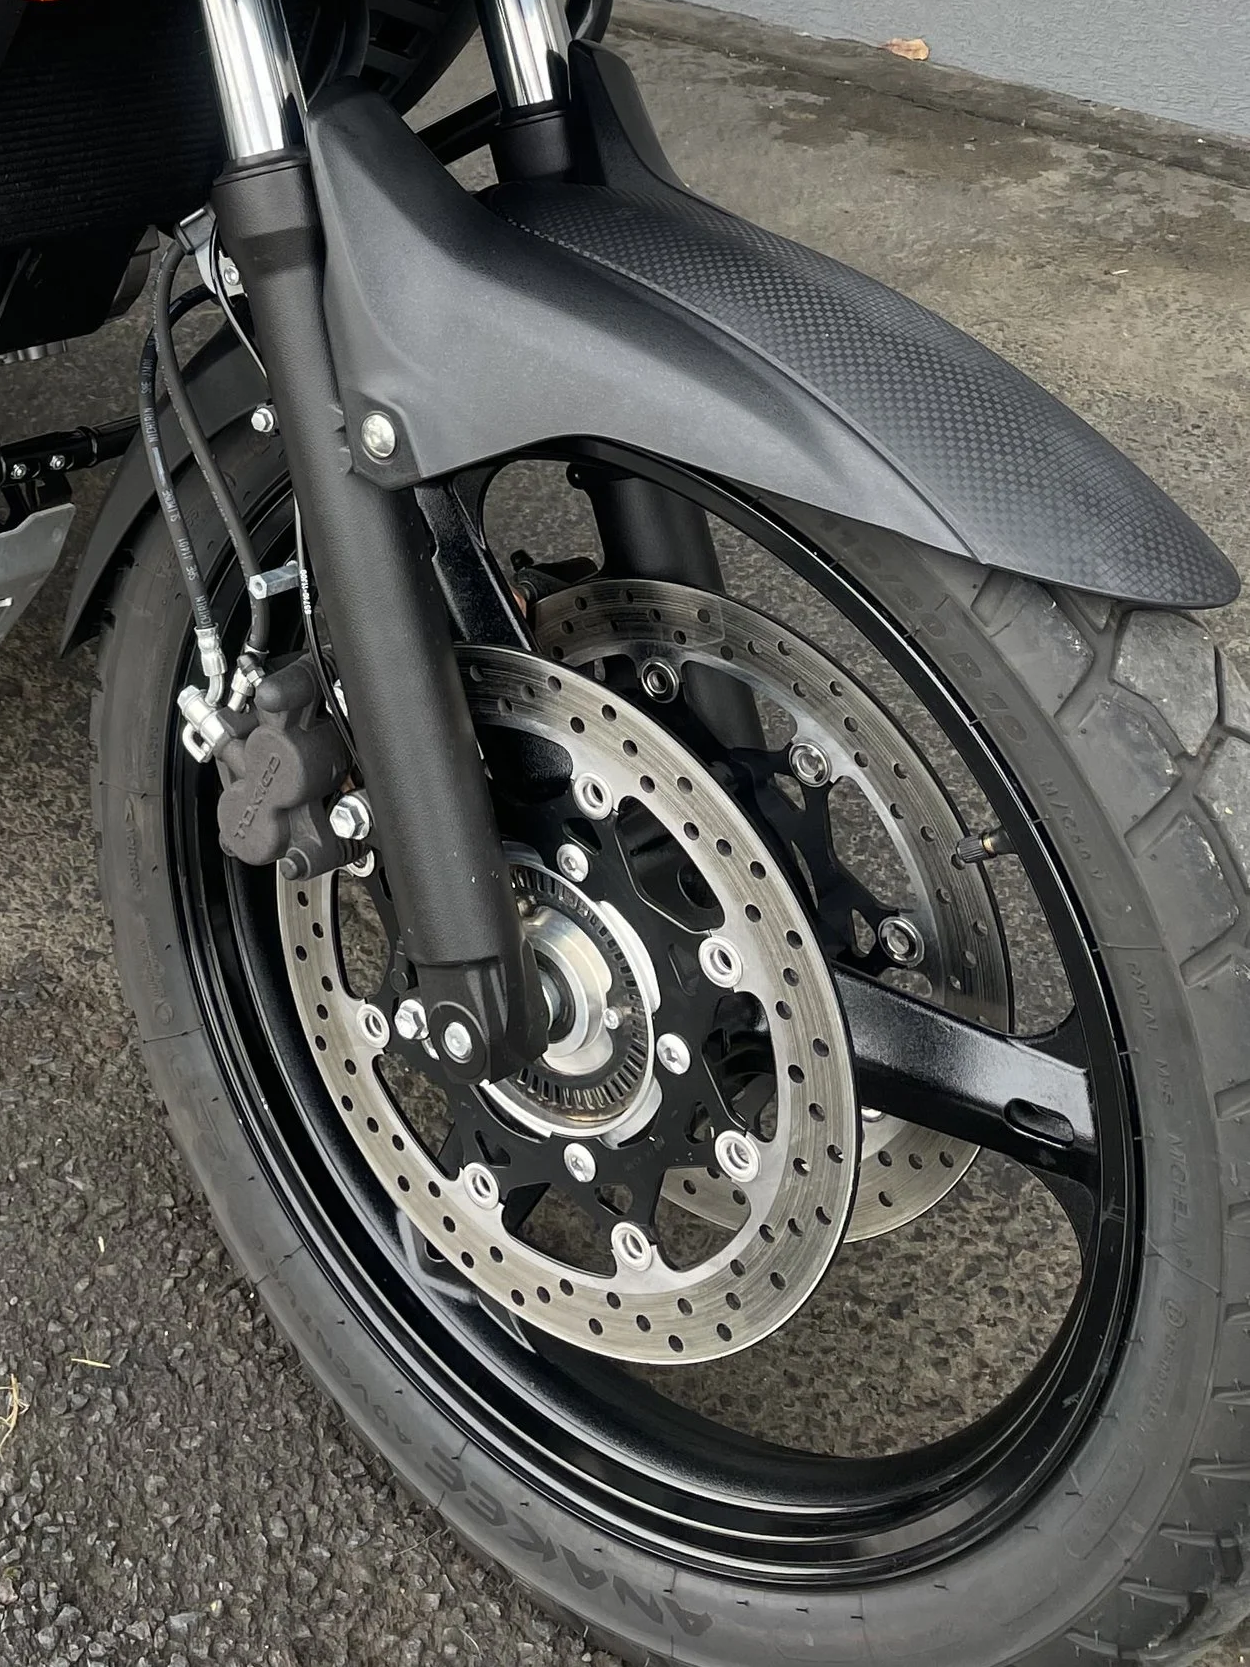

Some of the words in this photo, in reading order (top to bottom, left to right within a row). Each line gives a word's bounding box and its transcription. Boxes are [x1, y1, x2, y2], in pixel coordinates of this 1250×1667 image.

[195, 595, 214, 629] ICHIRIN
[233, 755, 281, 841] TOKICO
[424, 1444, 714, 1637] ANAKEE
